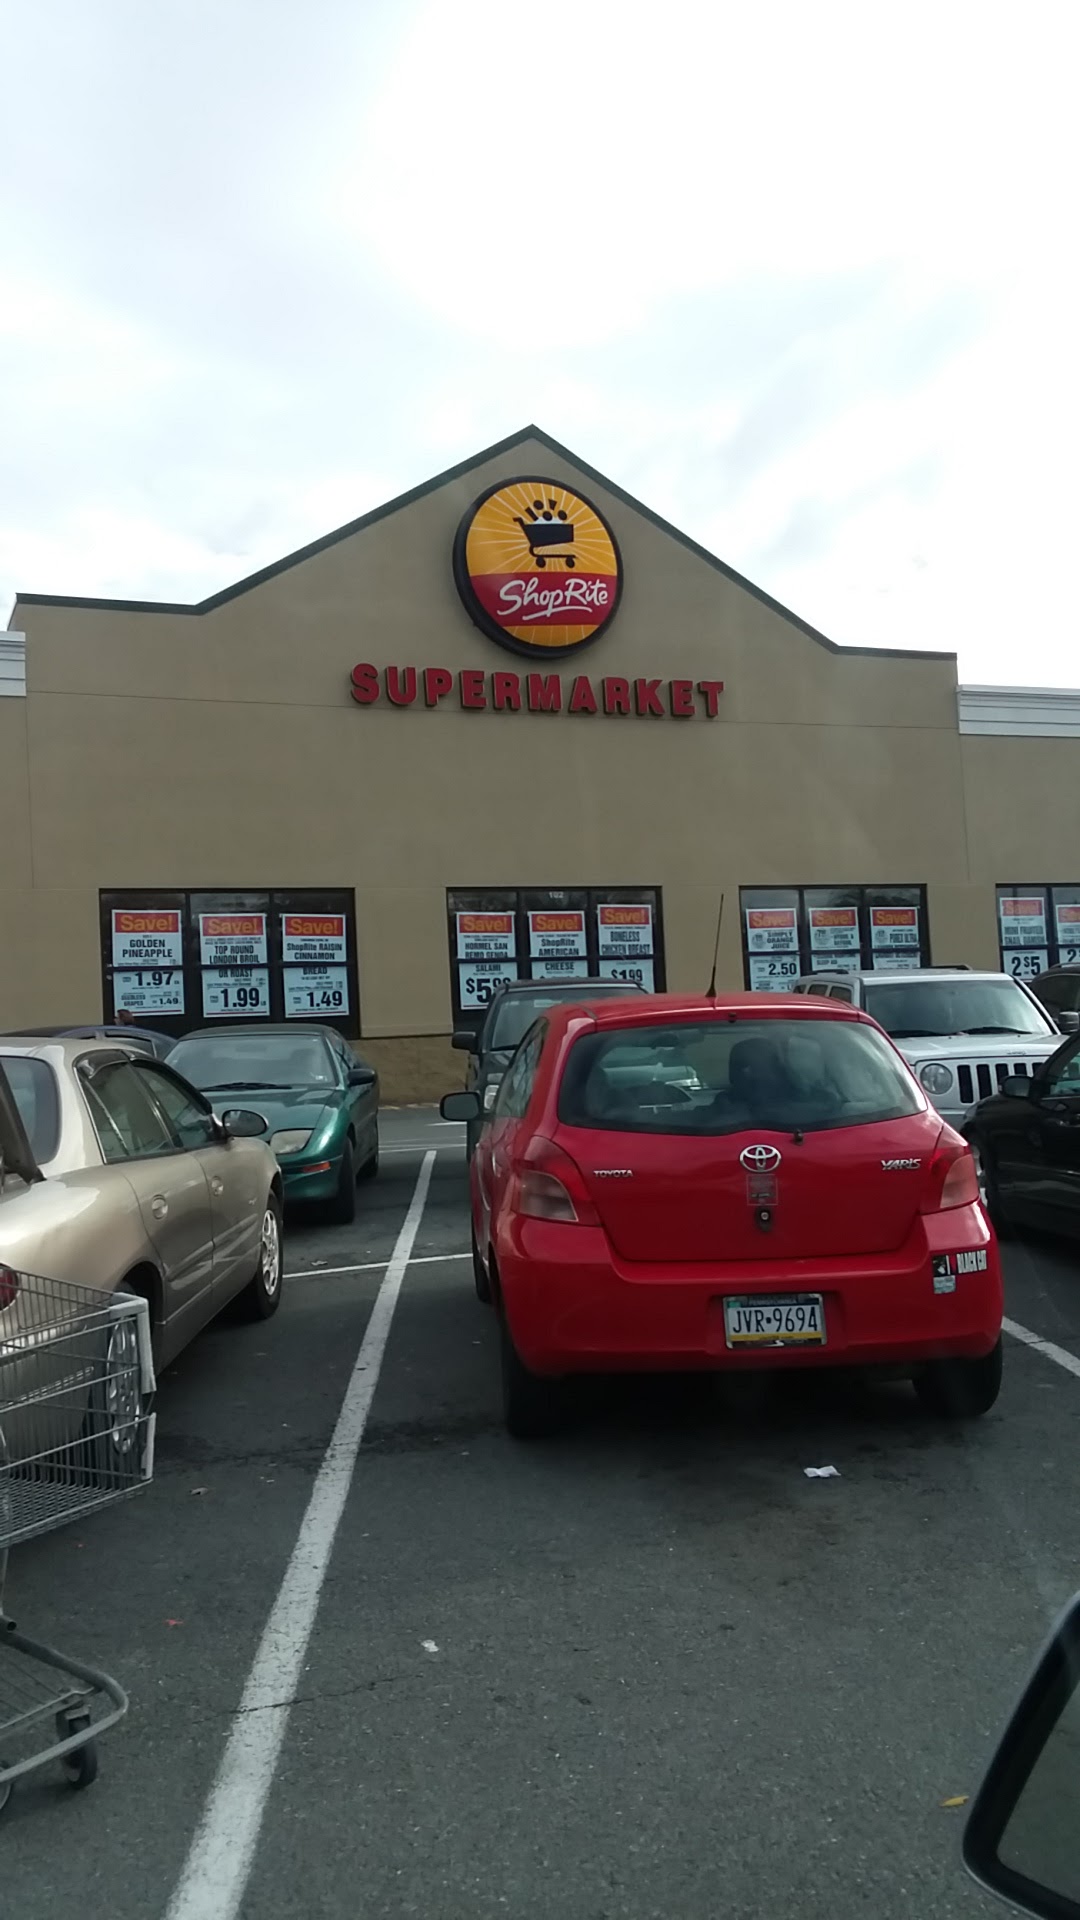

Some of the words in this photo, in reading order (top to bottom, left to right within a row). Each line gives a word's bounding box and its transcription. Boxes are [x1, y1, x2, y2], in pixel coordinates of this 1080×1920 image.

[496, 577, 609, 616] ShopRite
[350, 662, 724, 718] SUPERMARKET
[604, 908, 646, 924] Save!
[816, 911, 852, 925] Save!
[876, 911, 913, 925] Save!
[121, 915, 173, 931] Save!
[208, 918, 258, 934] Save!
[290, 918, 338, 934] Save!
[463, 916, 508, 932] Save!
[536, 915, 578, 931] Save!
[541, 939, 575, 947] ShopRite
[610, 931, 640, 942] BONELESS
[129, 939, 165, 948] GOLDEN
[214, 946, 229, 955] TOP
[230, 945, 254, 955] ROUND
[286, 942, 317, 951] ShopRite
[318, 942, 343, 951] RAISIN
[494, 942, 508, 950] SAN
[122, 949, 173, 958] PINEAPPLE
[294, 952, 335, 960] CINNAMON
[539, 948, 579, 956] AMERICAN
[209, 955, 238, 964] LONDON
[239, 954, 260, 963] BROIL
[475, 964, 501, 972] SALAMI
[545, 962, 575, 971] CHEESE
[768, 963, 797, 976] 2.50
[135, 971, 174, 986] 1.97
[159, 997, 179, 1005] 1.49
[220, 987, 260, 1008] 1.99
[306, 990, 343, 1007] 1.49
[880, 1157, 922, 1170] YARIS
[593, 1169, 634, 1178] TOYOTA
